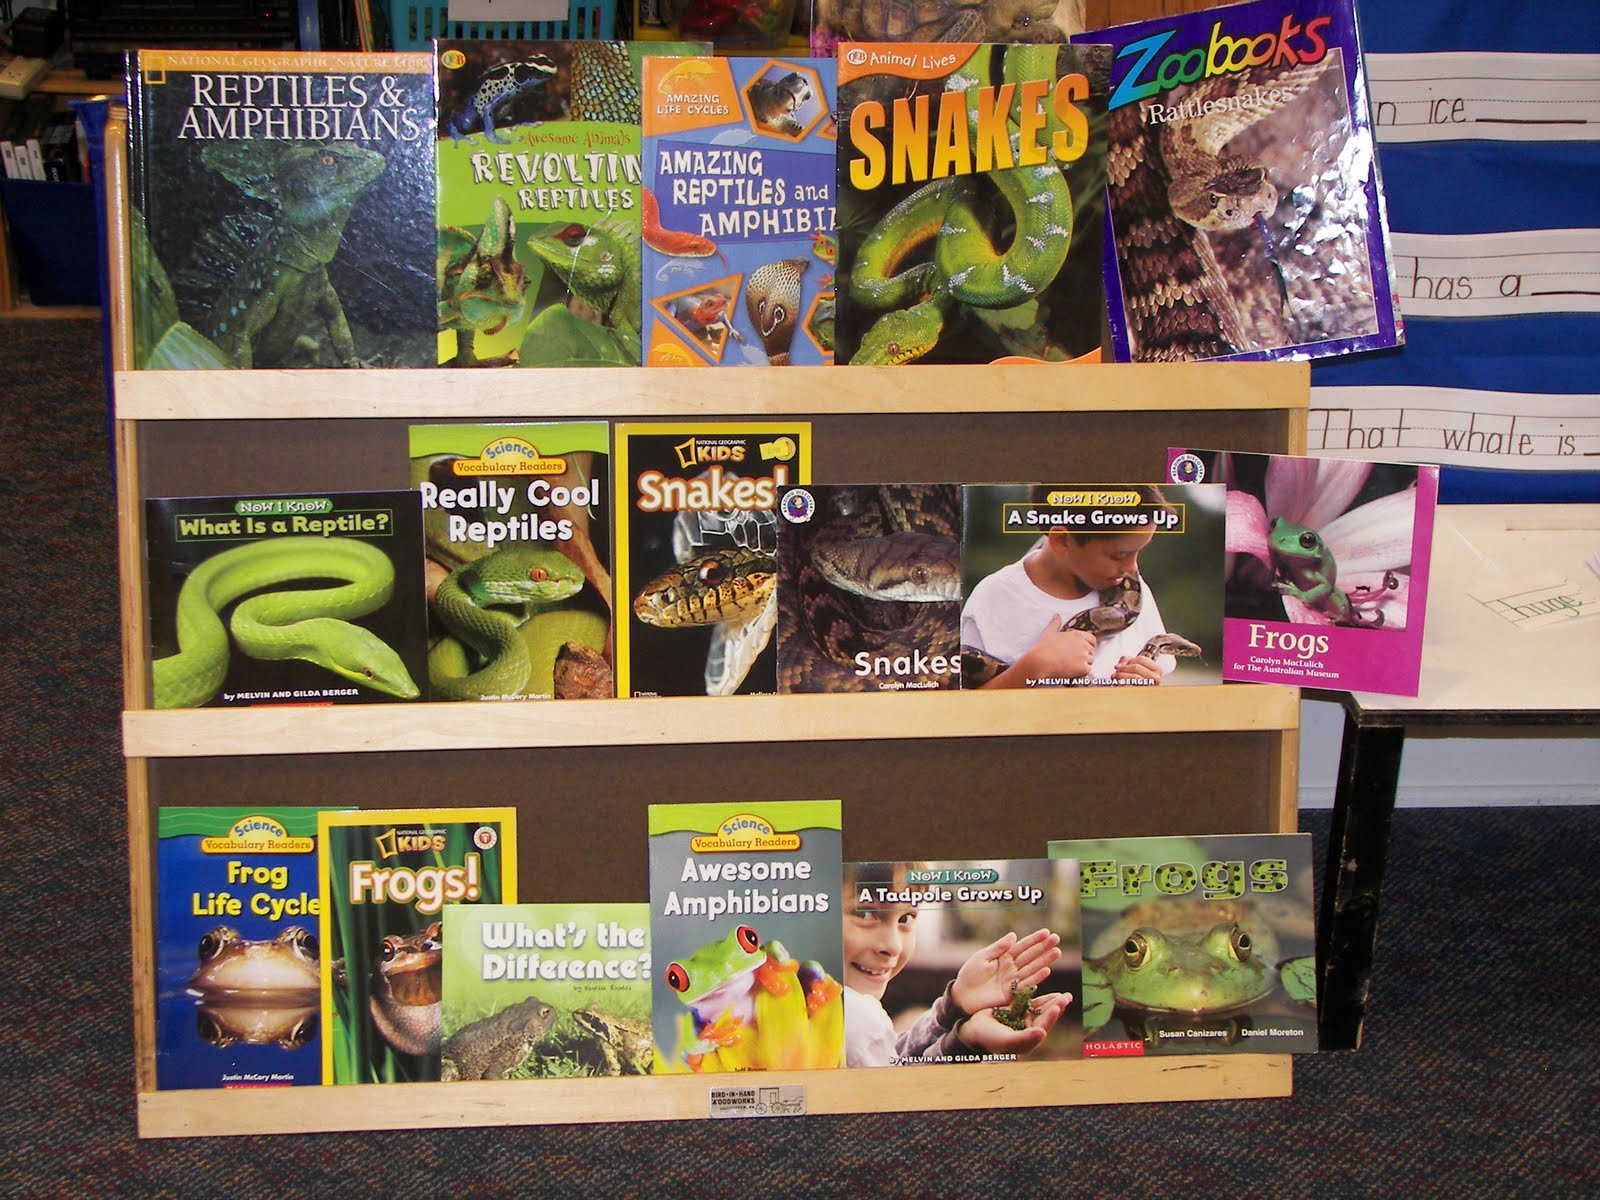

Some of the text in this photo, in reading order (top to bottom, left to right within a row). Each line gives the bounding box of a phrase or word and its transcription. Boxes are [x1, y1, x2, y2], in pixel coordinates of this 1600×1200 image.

[168, 56, 237, 67] NATIONAL
[243, 56, 328, 67] GEOGRAPHIC
[870, 51, 956, 69] Animal Lives
[1108, 13, 1331, 110] Zoobooks
[191, 74, 405, 108] REPTILES &
[667, 94, 720, 104] AMAZING
[657, 105, 729, 115] LIFE CYCLES
[1148, 86, 1294, 125] Rattlesnakes
[1429, 87, 1467, 125] ice
[177, 107, 421, 141] AMPHIBIANS
[850, 73, 1090, 190] SNAKES
[524, 130, 631, 148] Awesome Animals
[659, 150, 763, 177] AMAZING
[518, 187, 634, 210] REPTILES
[673, 178, 829, 206] REPTILES and
[1411, 256, 1522, 301] has a
[1309, 408, 1576, 456] That whale is
[485, 441, 535, 460] Science
[697, 446, 746, 462] KIDS
[457, 461, 563, 473] Vocabulary Readers
[239, 500, 327, 514] Now I Know
[420, 478, 600, 515] Really Cool
[1052, 492, 1136, 504] Now I Know
[179, 513, 389, 537] What Is a Reptile?
[1008, 510, 1179, 529] A Snake Grows Up
[449, 513, 573, 548] Reptiles
[1496, 595, 1582, 618] huge
[1248, 624, 1329, 659] Frogs
[854, 649, 961, 676] Snakes
[1247, 664, 1261, 672] The
[1263, 665, 1304, 675] Australian
[1306, 670, 1339, 678] Museum
[1250, 655, 1324, 669] Carolyn MacLulich
[879, 681, 904, 690] Carolyn
[1026, 678, 1037, 686] by
[223, 688, 359, 701] by MELVIN AND GILDA BERGER
[234, 820, 283, 837] Science
[723, 818, 770, 836] Science
[205, 839, 311, 850] Vocabulary Readers
[398, 835, 447, 852] KIDS
[695, 837, 797, 849] Vocabulary Readers
[228, 861, 288, 890] Frog
[680, 857, 812, 882] Awesome
[910, 869, 992, 882] Now I Know
[1080, 859, 1289, 899] Frogs
[351, 853, 480, 914] Frogs!
[664, 888, 830, 921] Amphibians
[859, 885, 1042, 906] A Tadpole Grows Up
[192, 892, 320, 921] Life Cycle
[481, 921, 647, 949] What's the
[482, 952, 652, 981] Difference?
[1159, 1028, 1304, 1038] Susan Canizares Daniel Moreton
[890, 1057, 899, 1065] by
[982, 1053, 1017, 1061] BERGER
[244, 1074, 270, 1082] McCory
